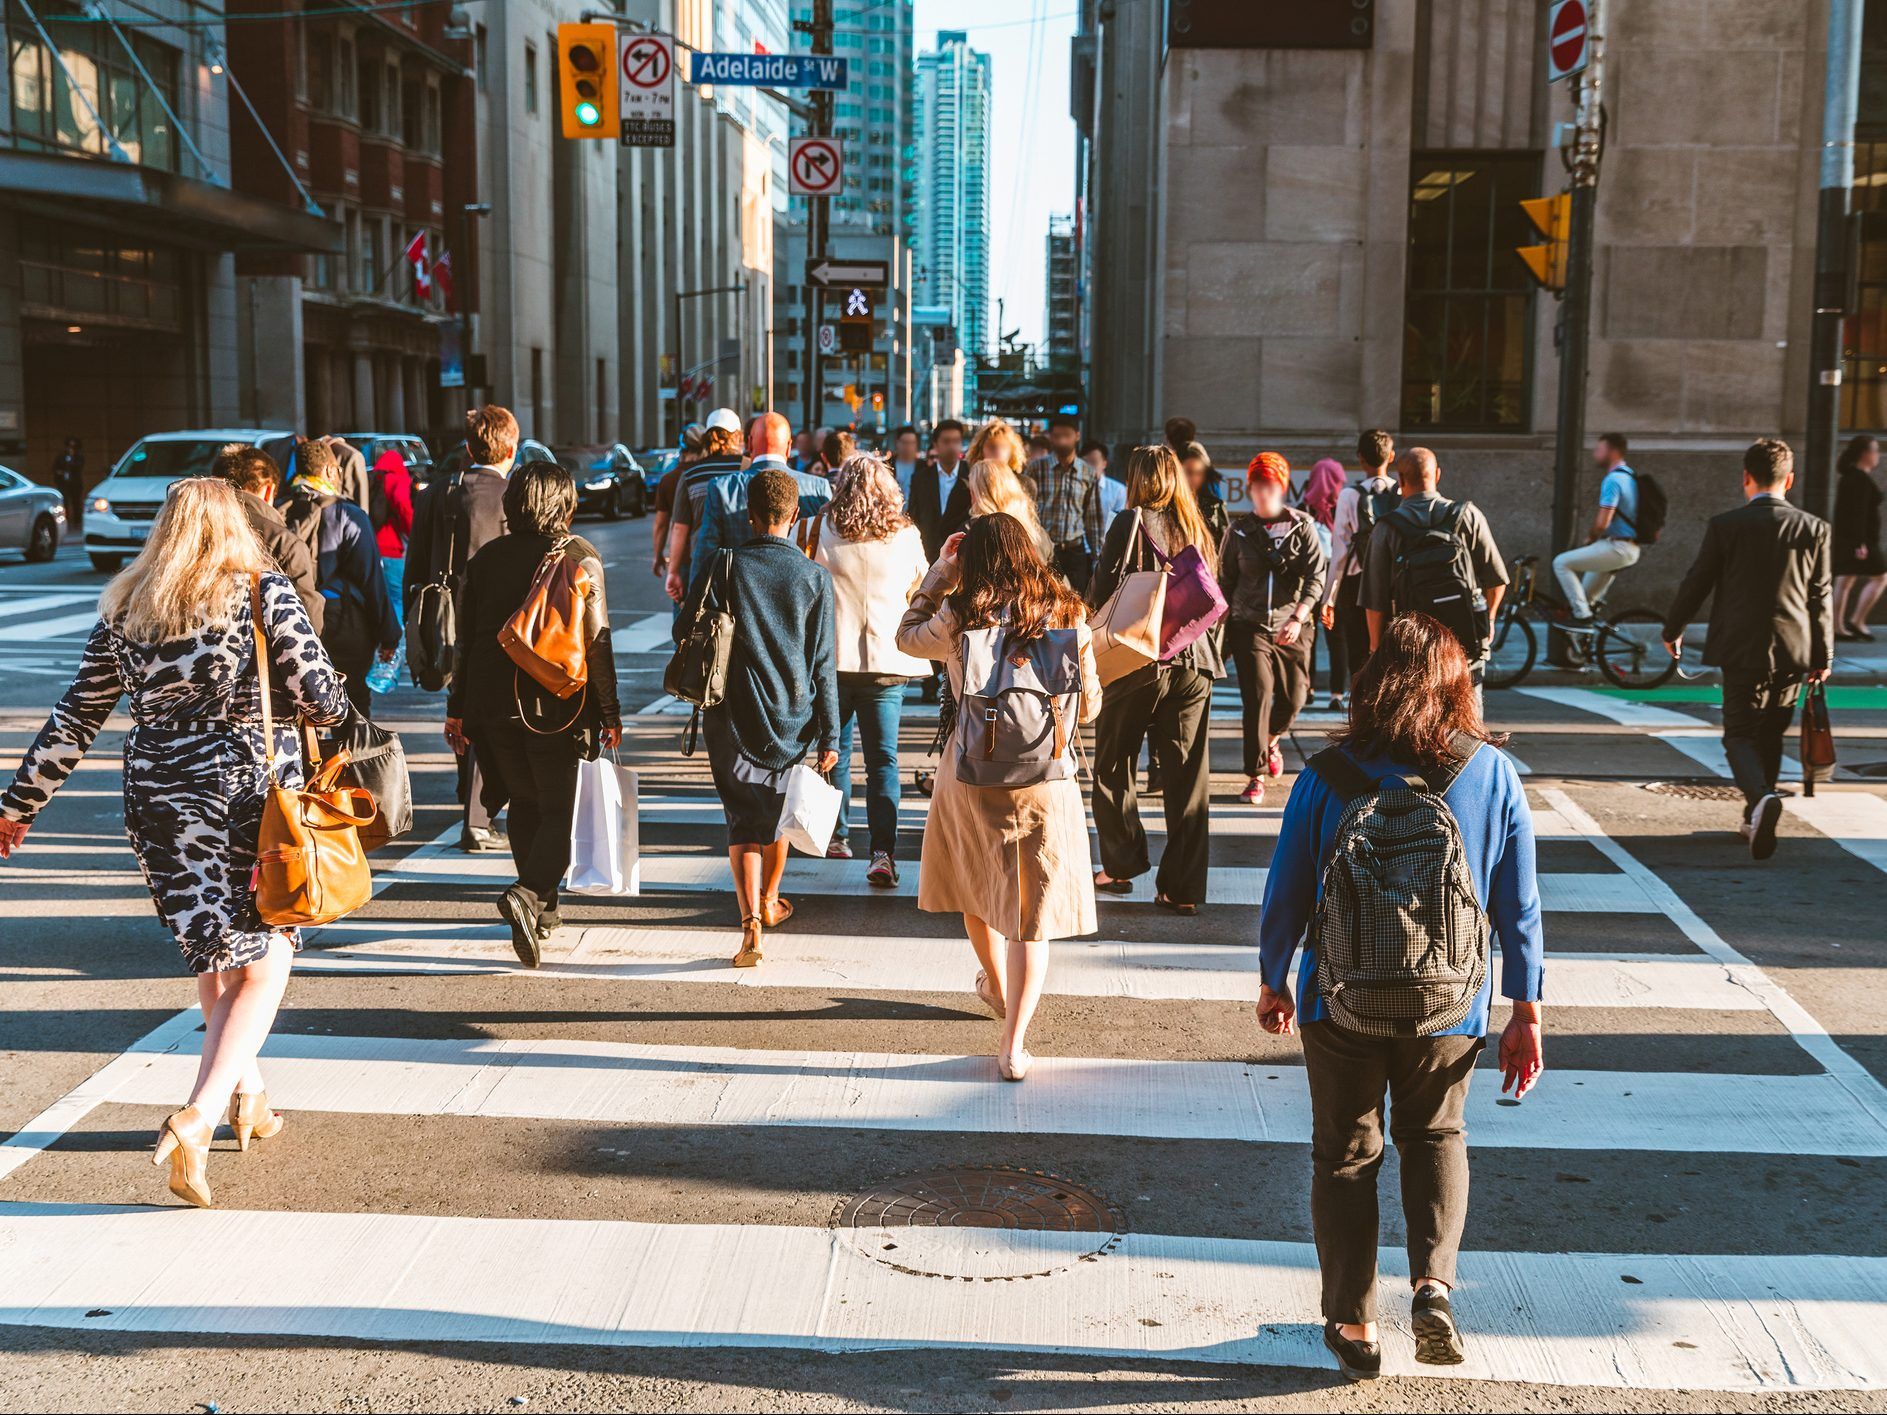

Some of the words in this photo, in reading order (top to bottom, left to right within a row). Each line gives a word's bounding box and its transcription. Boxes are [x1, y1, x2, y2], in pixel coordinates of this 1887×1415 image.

[700, 56, 798, 80] Adelaide
[803, 59, 814, 72] St
[819, 60, 838, 82] W
[624, 134, 671, 145] EXCEPTED
